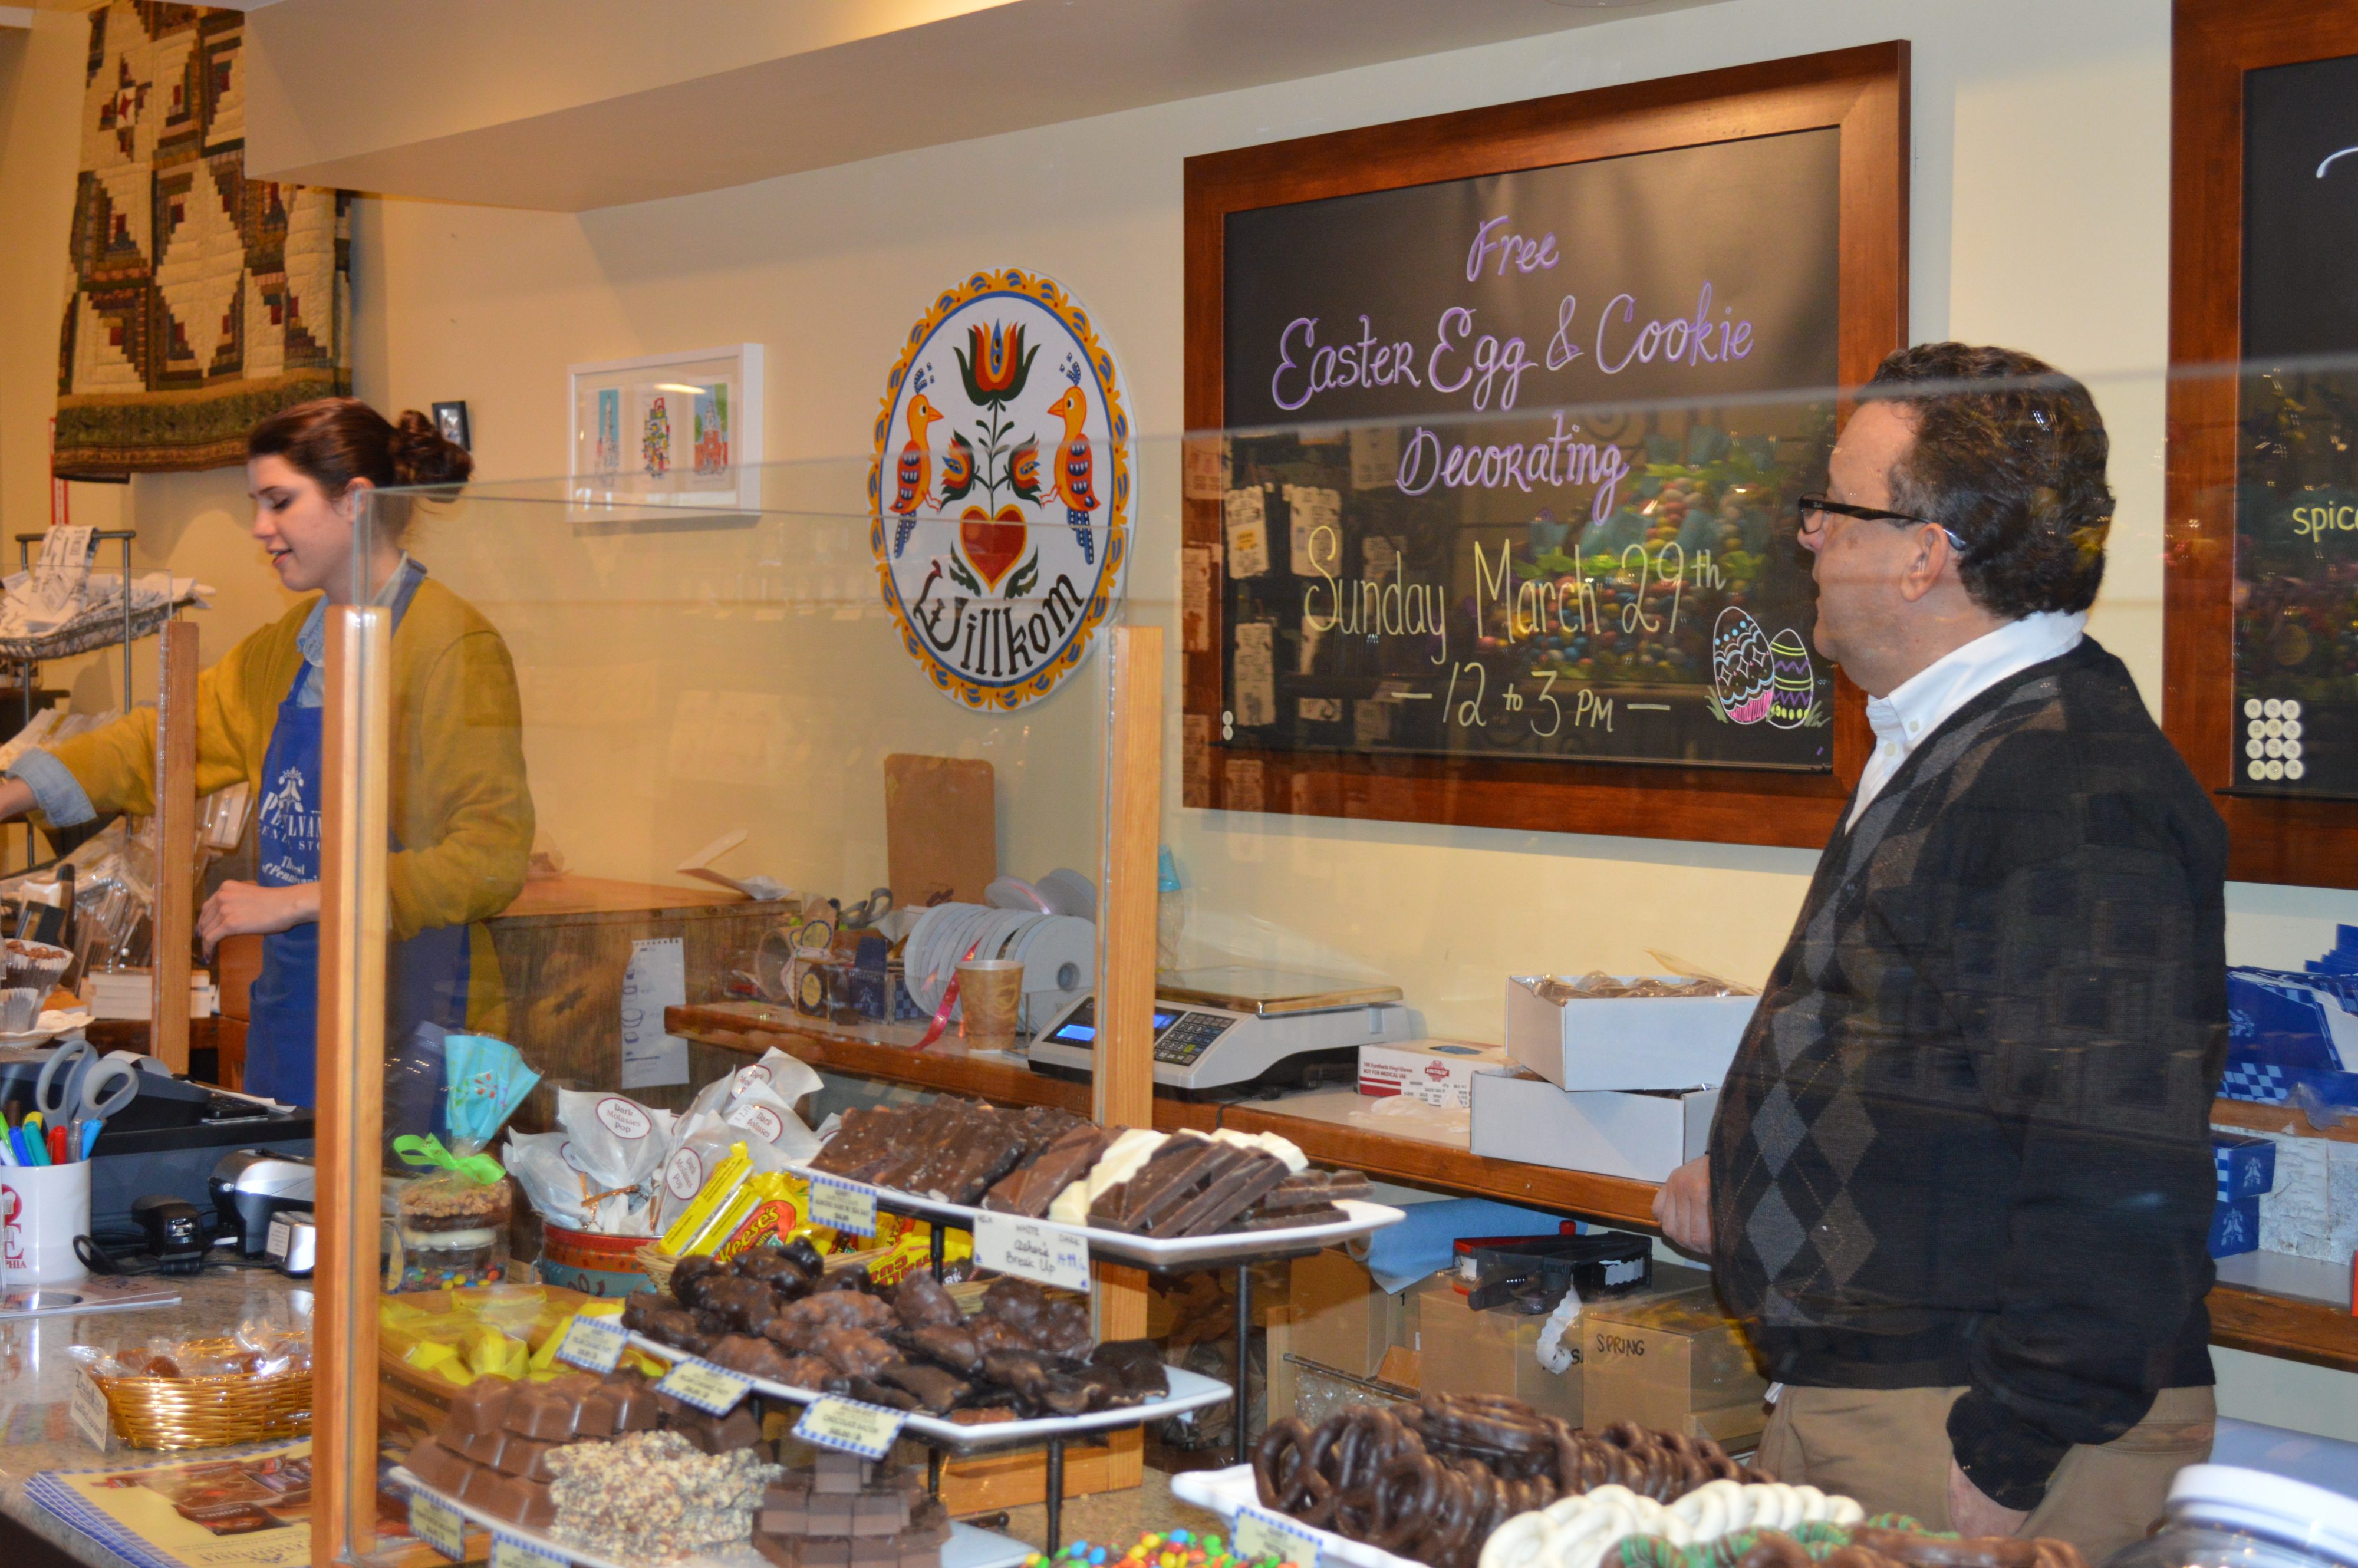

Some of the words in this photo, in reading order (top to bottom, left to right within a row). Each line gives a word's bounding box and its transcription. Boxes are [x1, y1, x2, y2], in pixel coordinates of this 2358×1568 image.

[1465, 215, 1559, 282] Free
[1428, 306, 1537, 411] Egg
[1546, 295, 1584, 371] &
[1596, 281, 1754, 373] Cookie
[1303, 525, 1446, 664] Sunday
[1474, 538, 1601, 644] March
[1441, 661, 1487, 727] 12
[1503, 684, 1523, 711] to
[1530, 670, 1560, 737] 3
[1575, 689, 1614, 732] PM
[607, 1109, 641, 1127] Molasses
[615, 1103, 634, 1116] Dark
[615, 1122, 631, 1133] Pop
[746, 1118, 771, 1138] olasses
[756, 1112, 773, 1126] Dark
[675, 1158, 693, 1189] Molasses
[686, 1157, 697, 1175] Dark
[673, 1174, 683, 1190] Pop
[1016, 1224, 1039, 1236] WHITE
[1059, 1234, 1080, 1246] DARK
[1039, 1259, 1056, 1276] Up
[1596, 1334, 1645, 1356] SPRING
